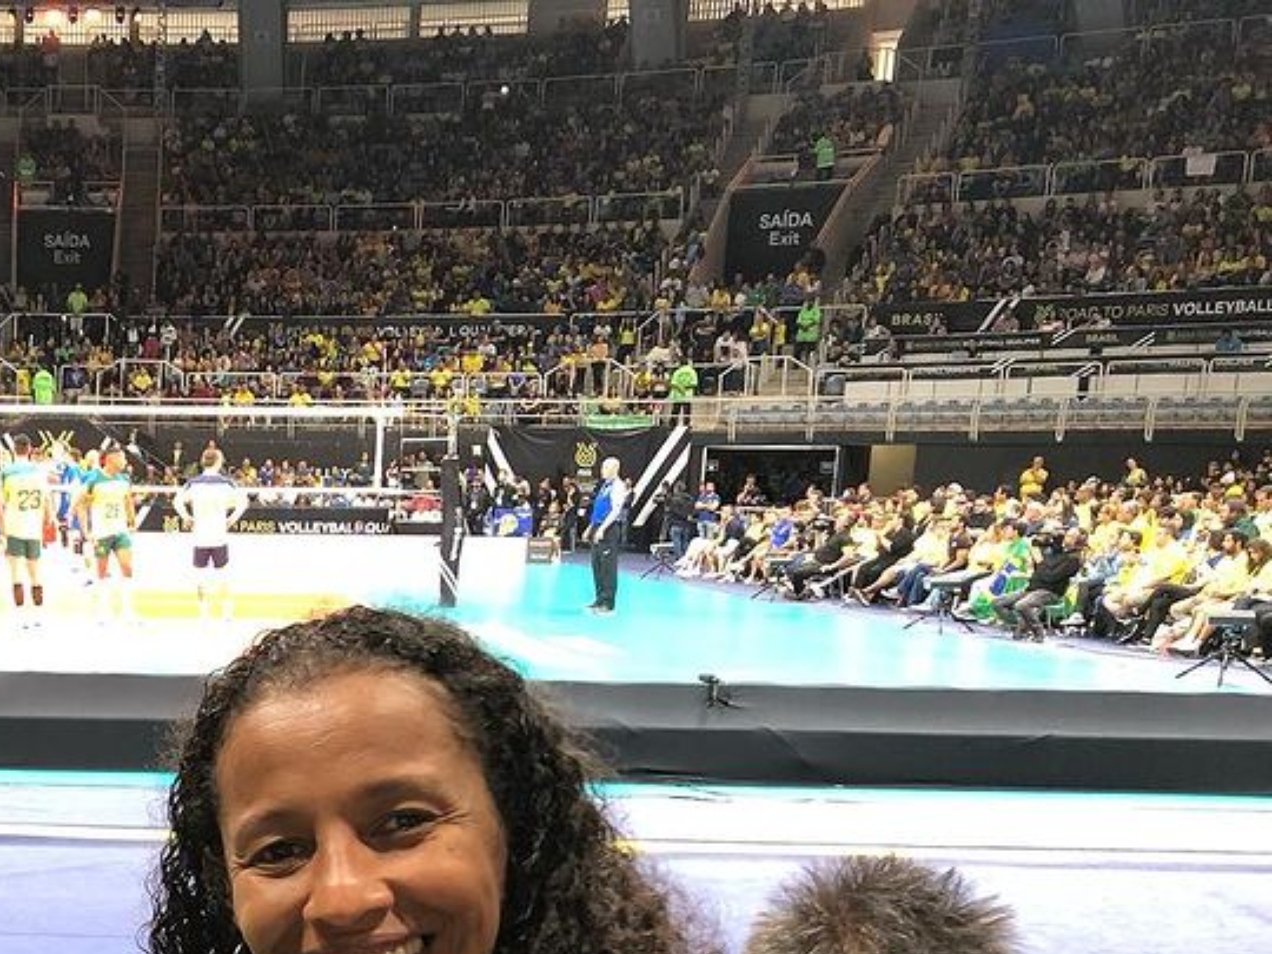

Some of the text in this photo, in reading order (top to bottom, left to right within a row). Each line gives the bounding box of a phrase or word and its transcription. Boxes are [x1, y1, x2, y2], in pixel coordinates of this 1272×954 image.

[759, 209, 813, 229] SAÍDA
[43, 230, 90, 248] SAÍDA
[769, 231, 800, 246] Exit
[54, 249, 81, 264] Exit
[1128, 303, 1169, 317] PARIS
[1172, 299, 1272, 316] VOLLEYBALL
[17, 490, 41, 511] 23
